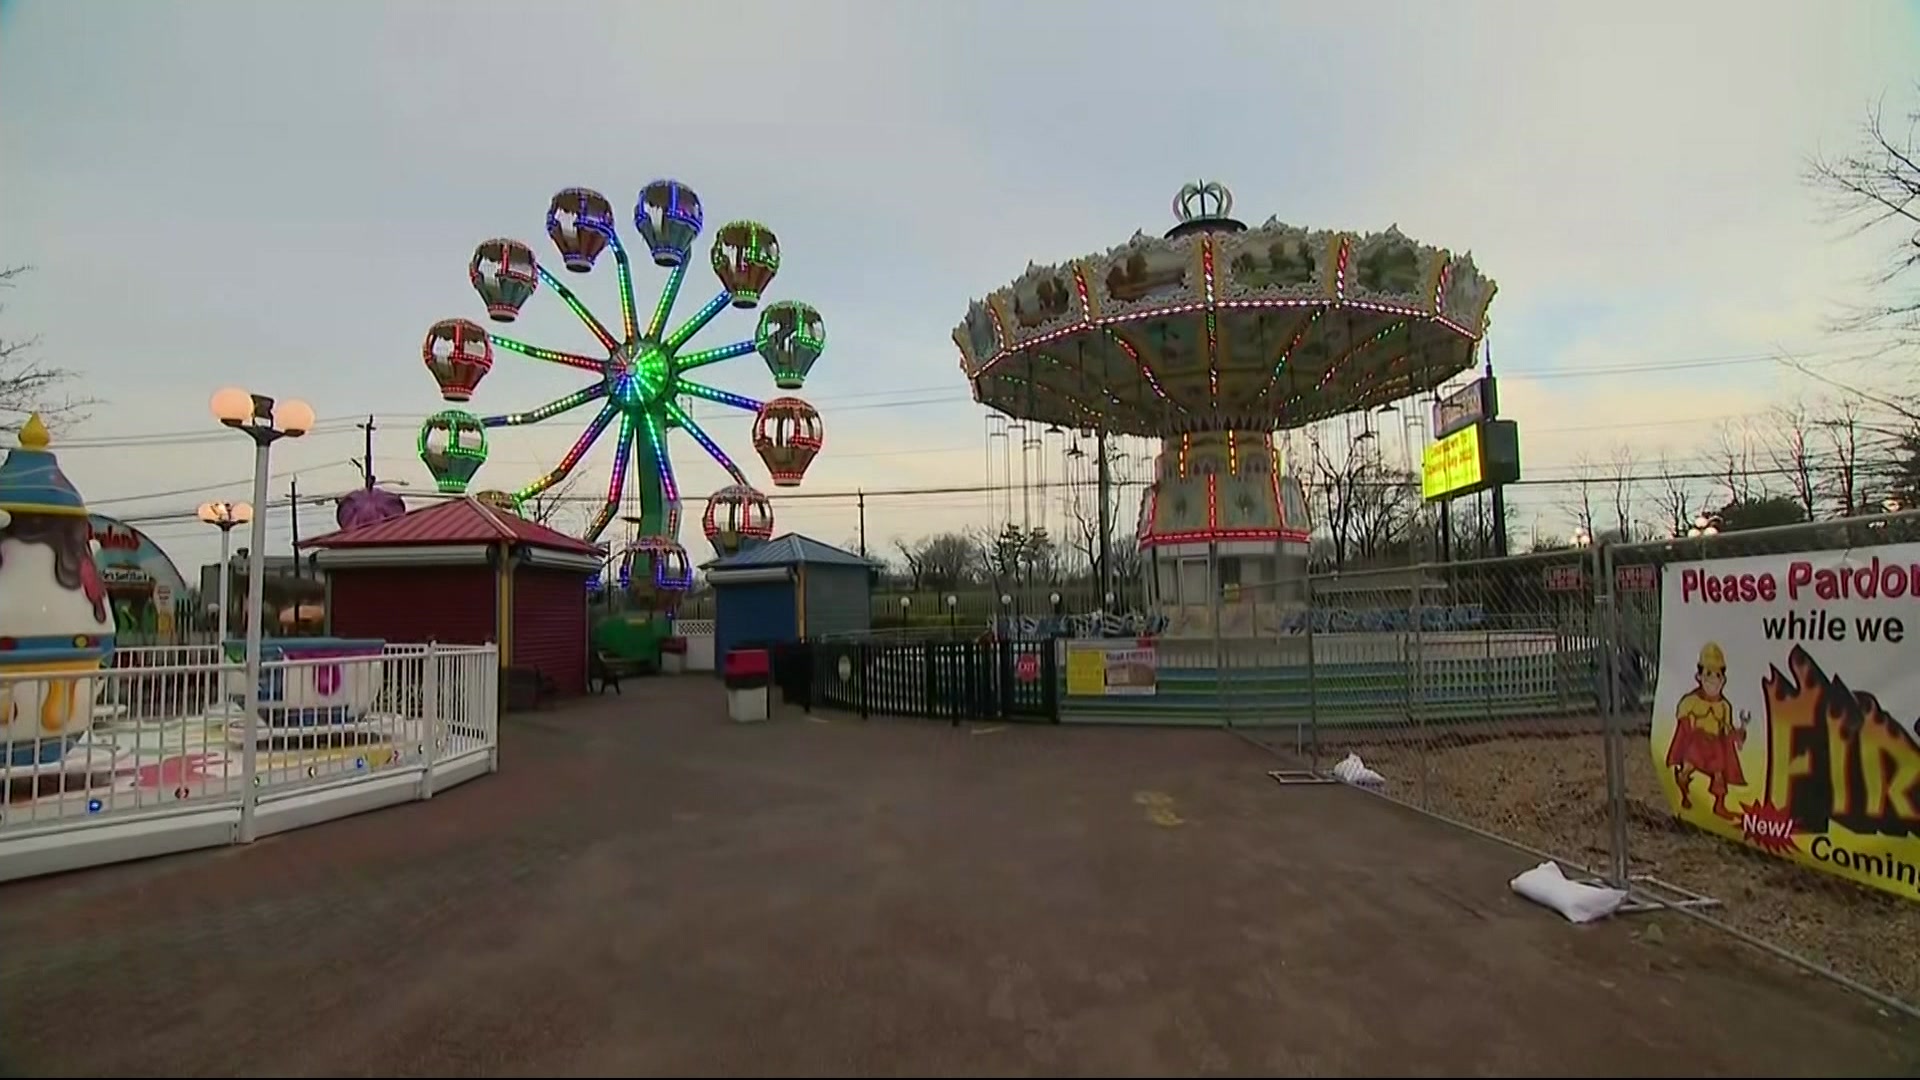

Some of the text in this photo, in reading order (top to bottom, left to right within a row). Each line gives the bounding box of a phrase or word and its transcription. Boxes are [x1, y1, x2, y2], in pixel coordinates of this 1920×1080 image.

[1682, 568, 1777, 603] Please
[1763, 610, 1905, 643] while we
[1742, 814, 1794, 839] New!
